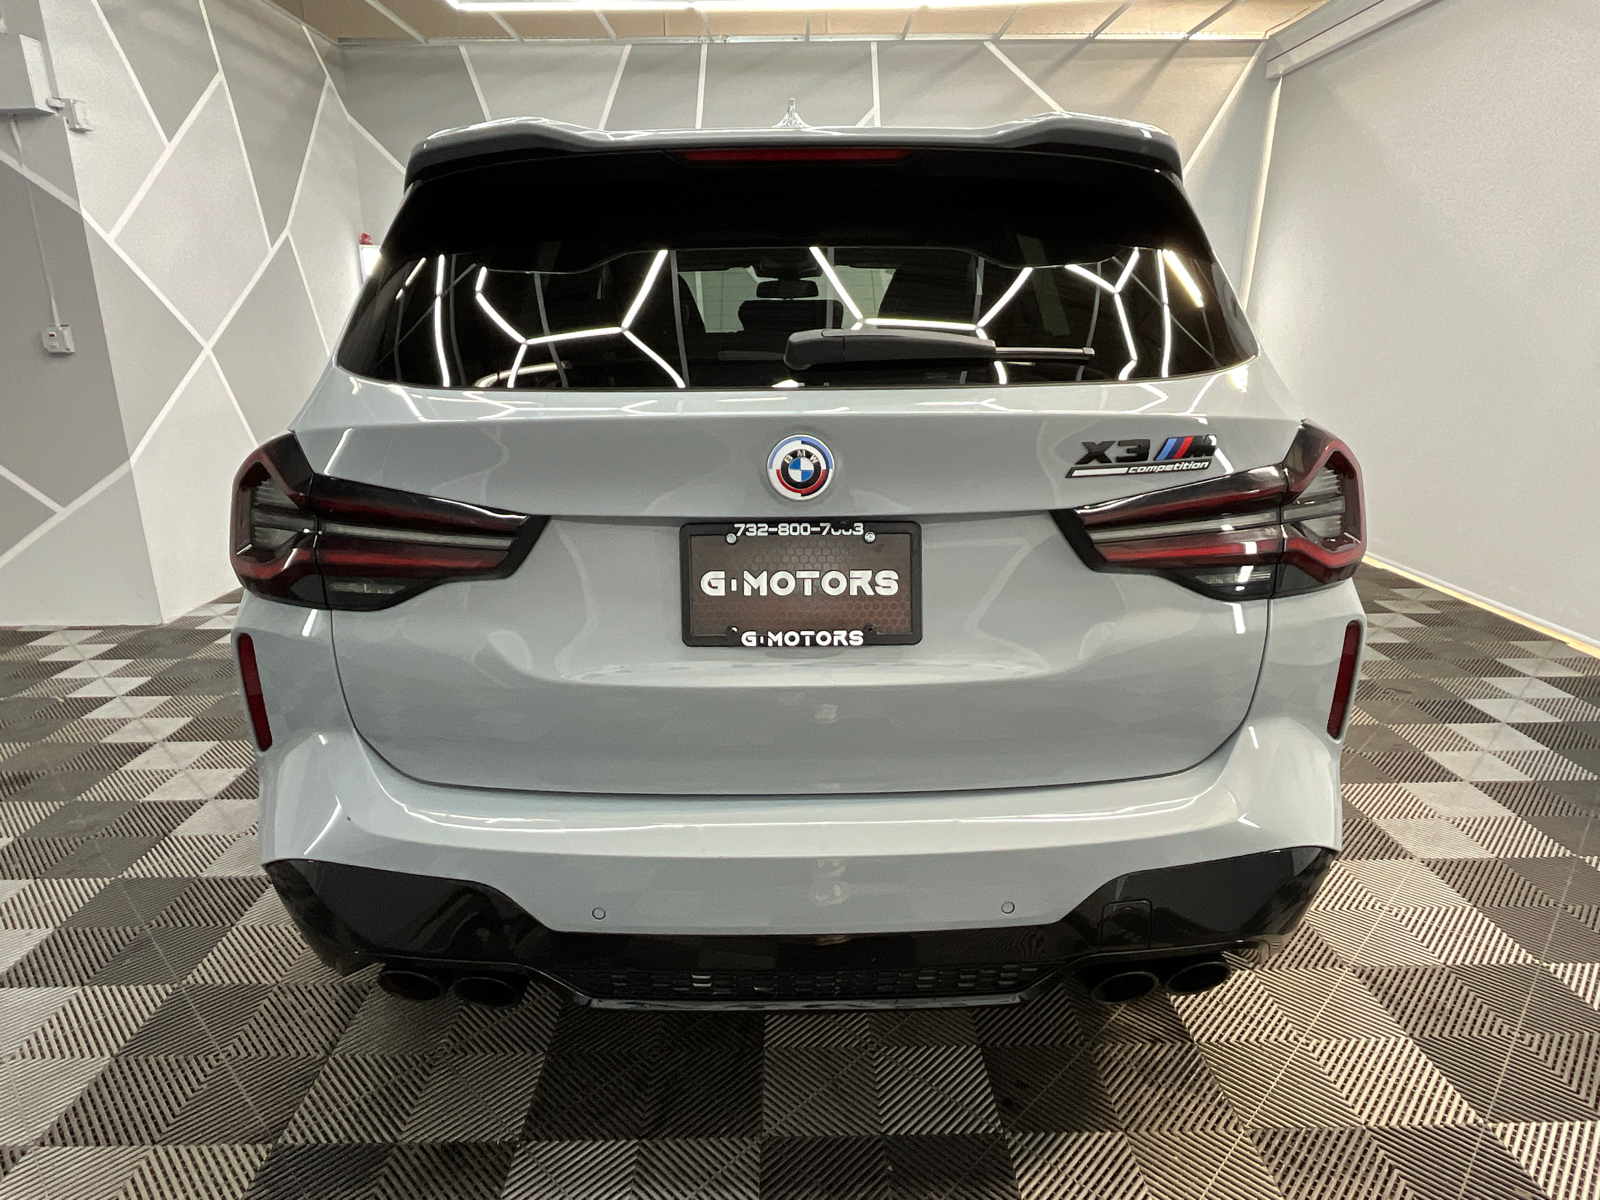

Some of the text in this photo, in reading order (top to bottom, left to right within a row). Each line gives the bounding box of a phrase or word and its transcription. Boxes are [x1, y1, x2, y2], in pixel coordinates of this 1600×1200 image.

[784, 449, 818, 464] BMW
[1075, 439, 1150, 465] X3
[1128, 461, 1209, 474] competition
